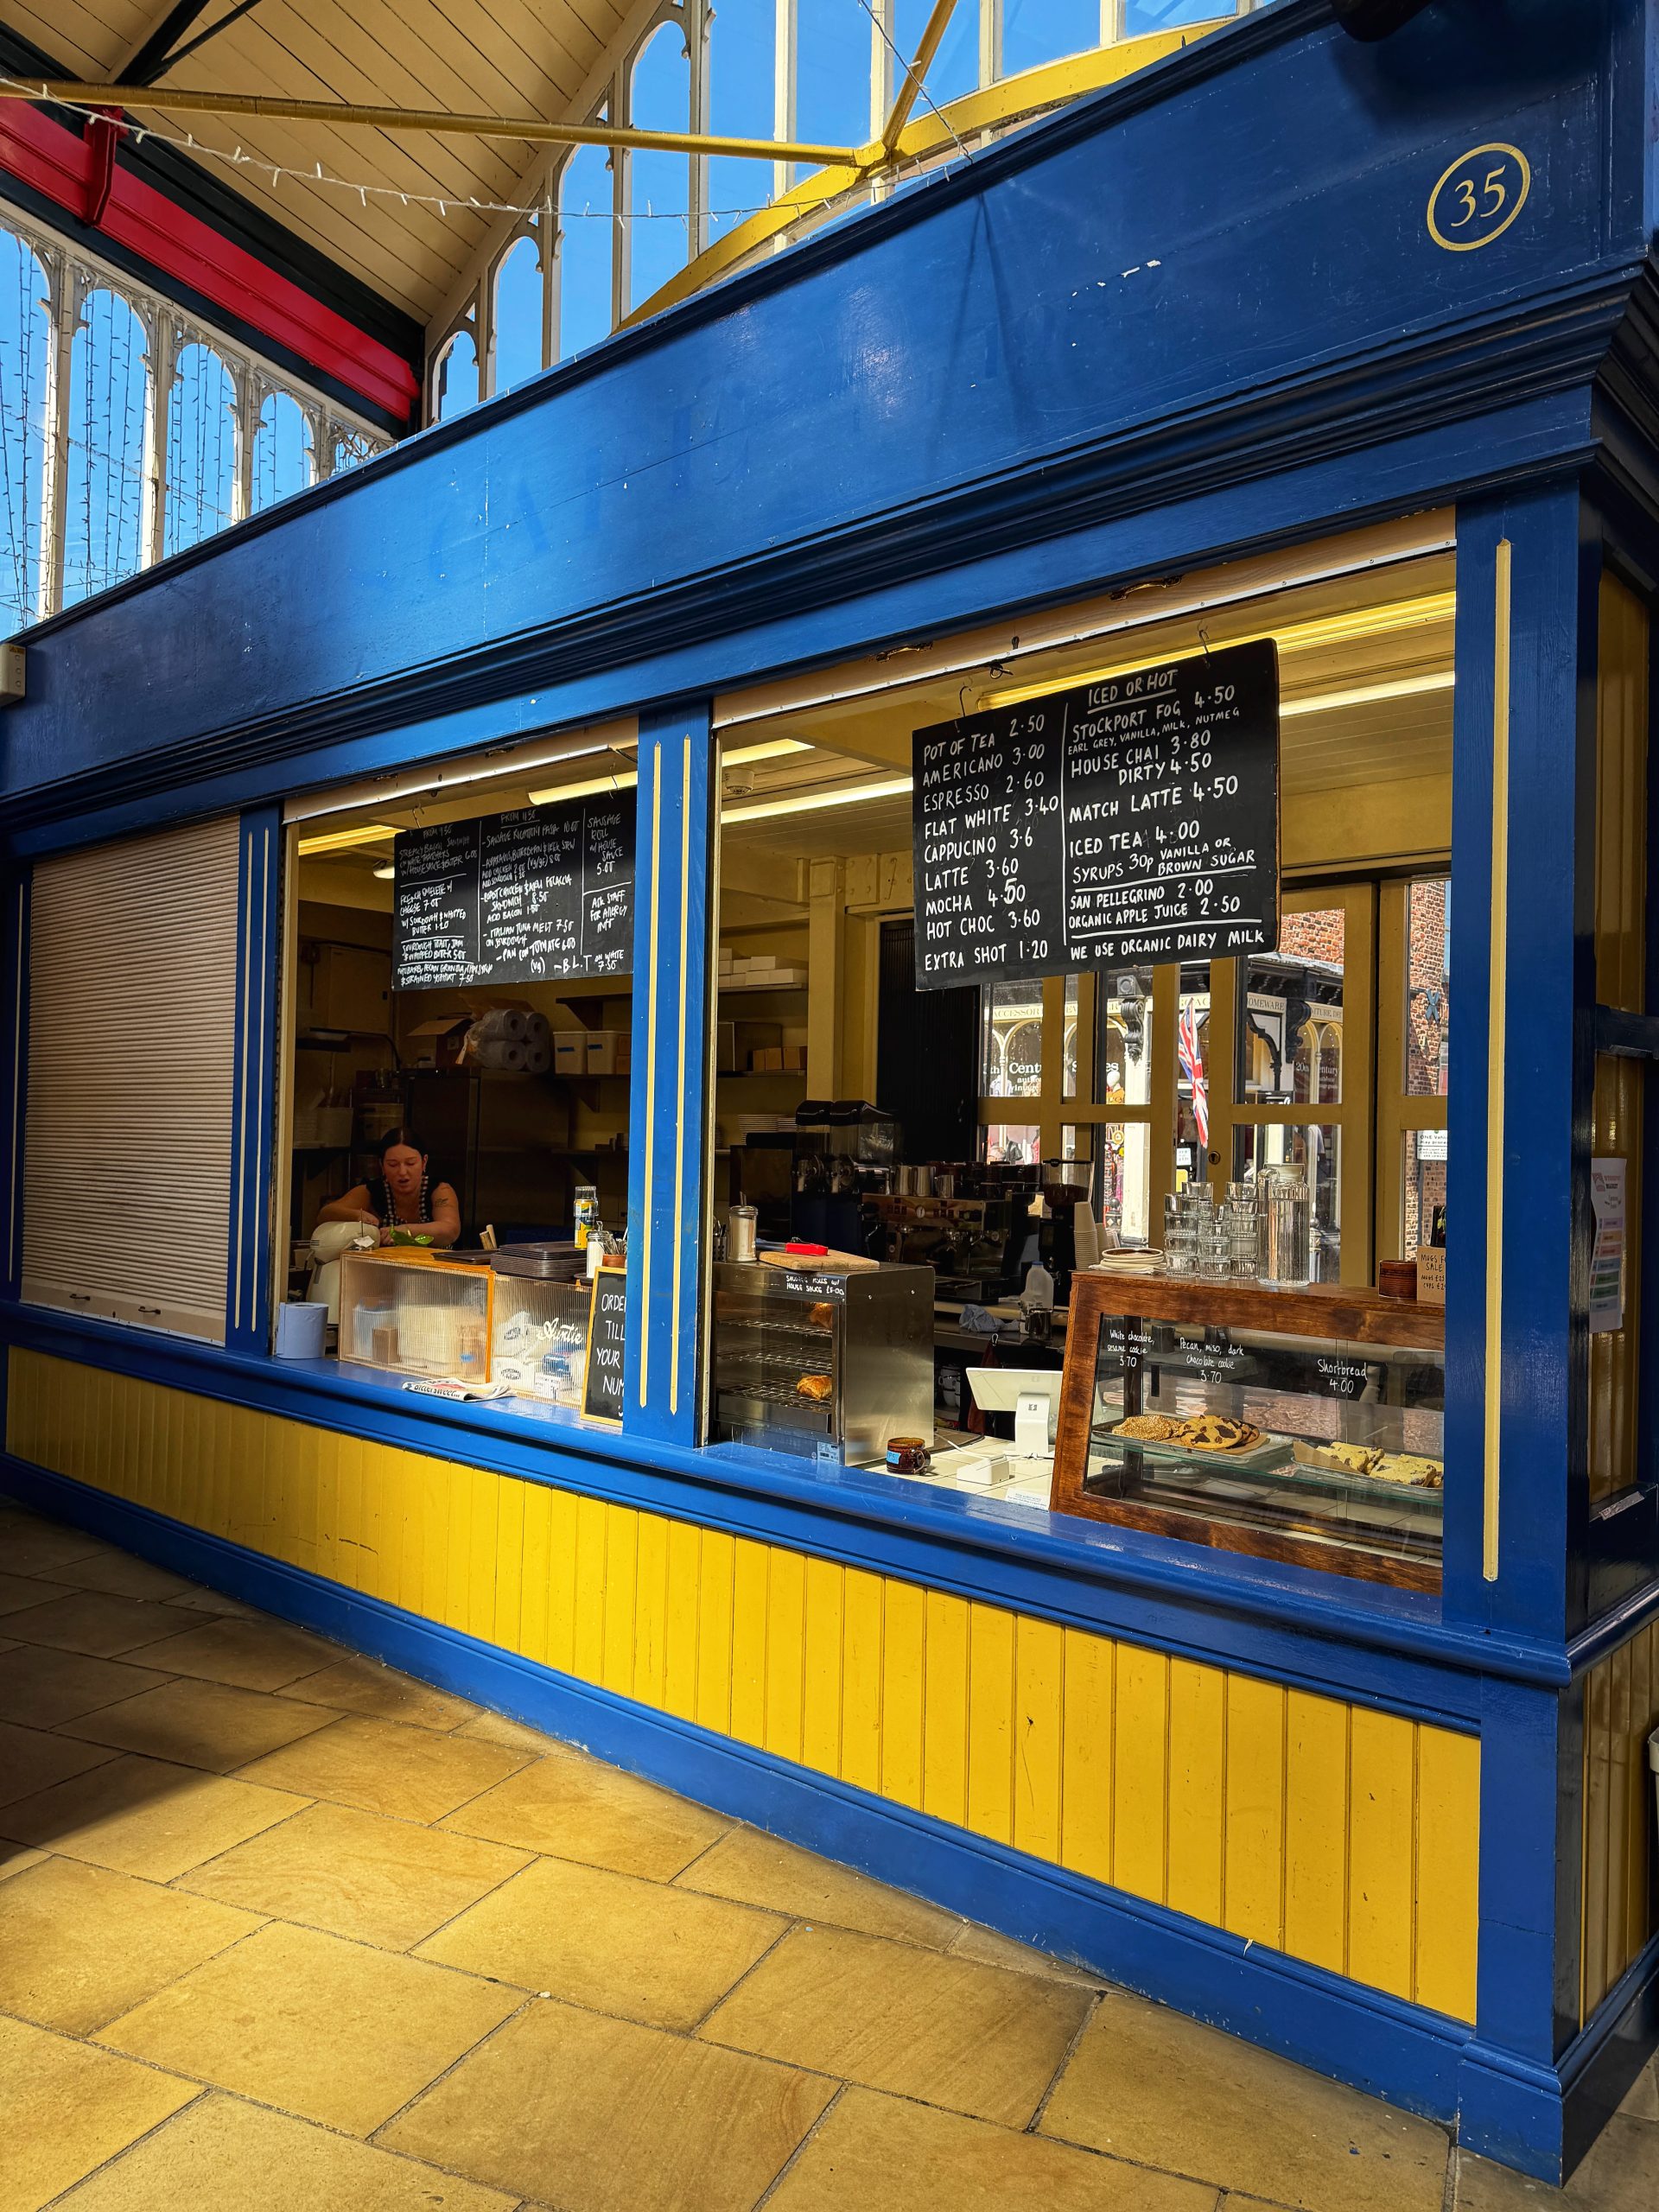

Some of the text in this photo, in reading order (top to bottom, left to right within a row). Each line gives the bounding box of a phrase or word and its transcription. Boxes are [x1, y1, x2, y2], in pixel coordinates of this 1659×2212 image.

[1450, 164, 1506, 227] 35
[1088, 669, 1178, 708] ICED OR HOT
[1068, 707, 1240, 756] EARL GREY, VANILLA, MILK, NUTMEG
[1072, 709, 1147, 743] STOCKPORT
[1156, 701, 1181, 719] FOG
[924, 744, 946, 761] POT
[950, 740, 966, 754] OF
[971, 734, 995, 751] TEA
[923, 753, 1003, 787] AMERICANO
[1071, 749, 1119, 779] HOUSE
[1126, 745, 1160, 766] CHAI
[1118, 761, 1166, 786] DIRTY
[923, 785, 989, 813] ESPRESSO
[1069, 799, 1119, 824] MATCH
[1131, 786, 1182, 813] LATTE
[591, 828, 609, 841] ROLL
[925, 818, 957, 840] FLAT
[965, 804, 1011, 830] WHITE
[924, 837, 997, 864] CAPPUCINO
[1070, 836, 1103, 858] ICED
[1109, 830, 1142, 852] TEA
[1160, 837, 1232, 861] VANILLA OR
[1072, 853, 1154, 884] SYRUPS 30p
[1158, 849, 1255, 875] BROWN SUGAR
[925, 867, 969, 892] LATTE
[925, 896, 973, 917] MOCHA
[1070, 893, 1093, 910] SAN
[1096, 886, 1166, 909] PELLEGRINO
[532, 922, 553, 933] MELT
[926, 920, 953, 941] HOT
[960, 915, 995, 936] CHOC
[1068, 911, 1113, 931] ORGANIC
[1116, 906, 1149, 925] APPLE
[1154, 903, 1188, 919] JUICE
[925, 952, 964, 972] EXTRA
[975, 944, 1007, 963] SHOT
[1071, 930, 1265, 961] WE USE ORGANIC DAIRY MILK
[1249, 997, 1285, 1011] OMEWARE
[1426, 1262, 1443, 1272] SALE
[606, 1320, 626, 1341] TILL
[1109, 1329, 1126, 1340] White
[597, 1347, 620, 1369] YOUR
[1180, 1338, 1244, 1356] Pecan, miso, dark
[1186, 1354, 1235, 1369] chocolate cookie
[1318, 1358, 1368, 1380] Shortbread
